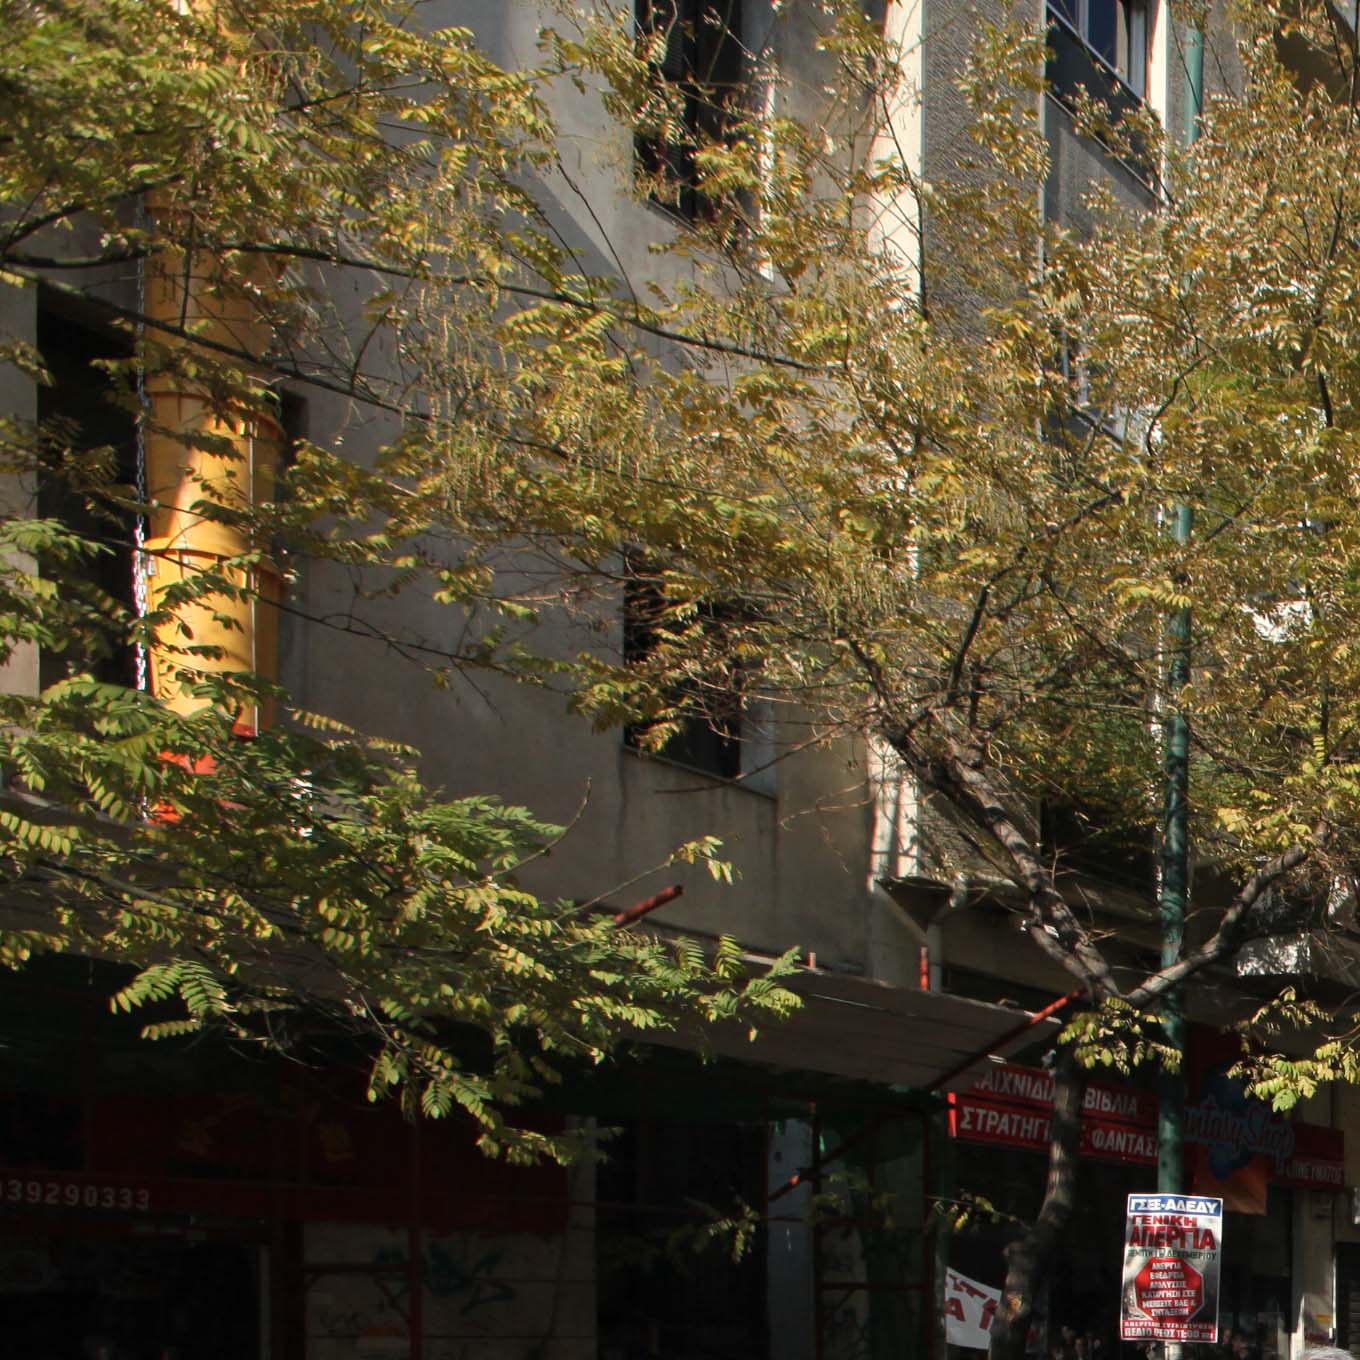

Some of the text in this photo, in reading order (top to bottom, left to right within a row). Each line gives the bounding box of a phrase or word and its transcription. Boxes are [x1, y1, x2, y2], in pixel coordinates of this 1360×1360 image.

[1084, 1087, 1138, 1118] ΒΙΒΛΙΑ
[960, 1106, 1059, 1143] ΣΤΡΑΤΗΓΙ
[1130, 1198, 1218, 1214] ΓΣΕΕ-ΑΔΕΔΥ
[1131, 1215, 1198, 1227] ΓΕΝΙΚΗ
[1128, 1225, 1217, 1250] ΑΠΕΡΓΙΑ
